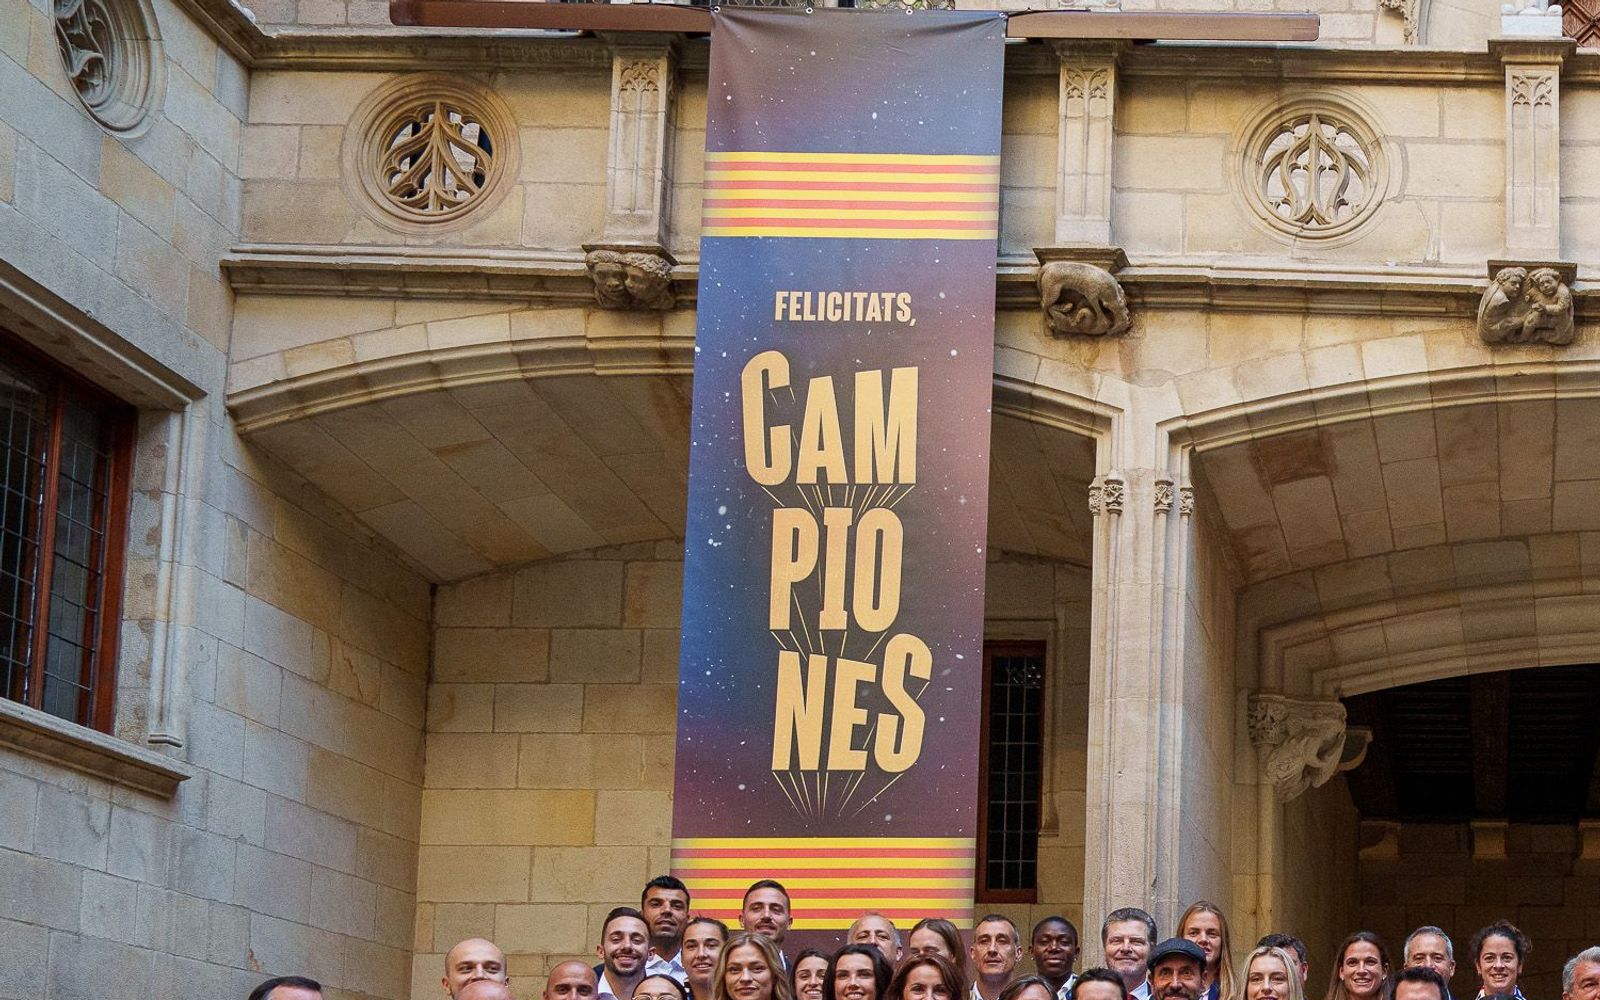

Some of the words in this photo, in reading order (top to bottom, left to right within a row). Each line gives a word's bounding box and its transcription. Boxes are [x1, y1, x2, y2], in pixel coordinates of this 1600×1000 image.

[774, 290, 916, 326] FELICITATS,
[741, 350, 919, 486] CAM
[769, 507, 904, 632] PIO
[771, 633, 933, 773] NES
